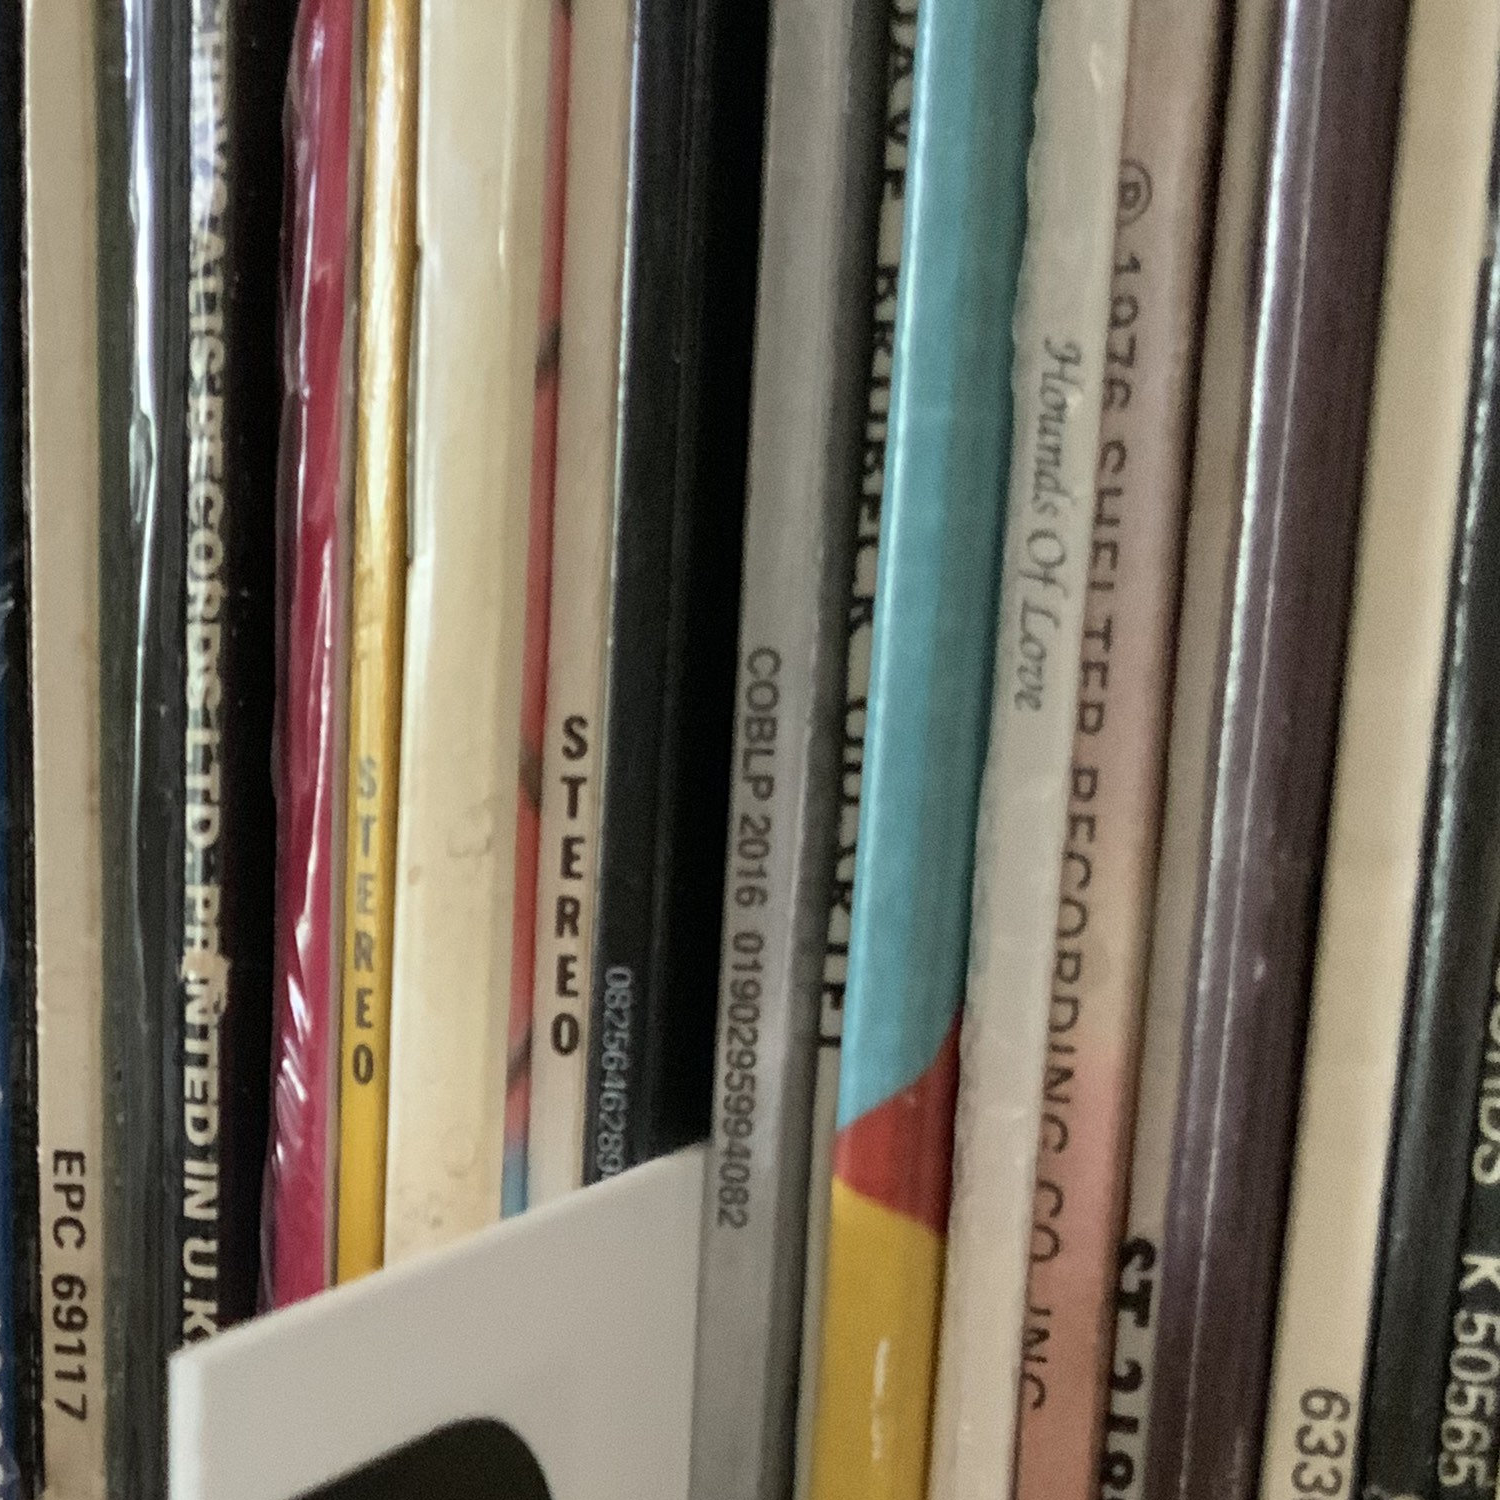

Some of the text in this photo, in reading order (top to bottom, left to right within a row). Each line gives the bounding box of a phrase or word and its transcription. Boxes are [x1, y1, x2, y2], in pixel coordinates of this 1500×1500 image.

[1013, 336, 1083, 713] Hounds Of Love
[352, 754, 378, 1086] STEREO
[550, 714, 589, 1058] STEREO
[716, 645, 782, 1231] COBLP 2016 0190295994082
[50, 1147, 89, 1425] EPC 69117
[183, 1160, 220, 1222] IN
[1436, 1309, 1500, 1488] 50565
